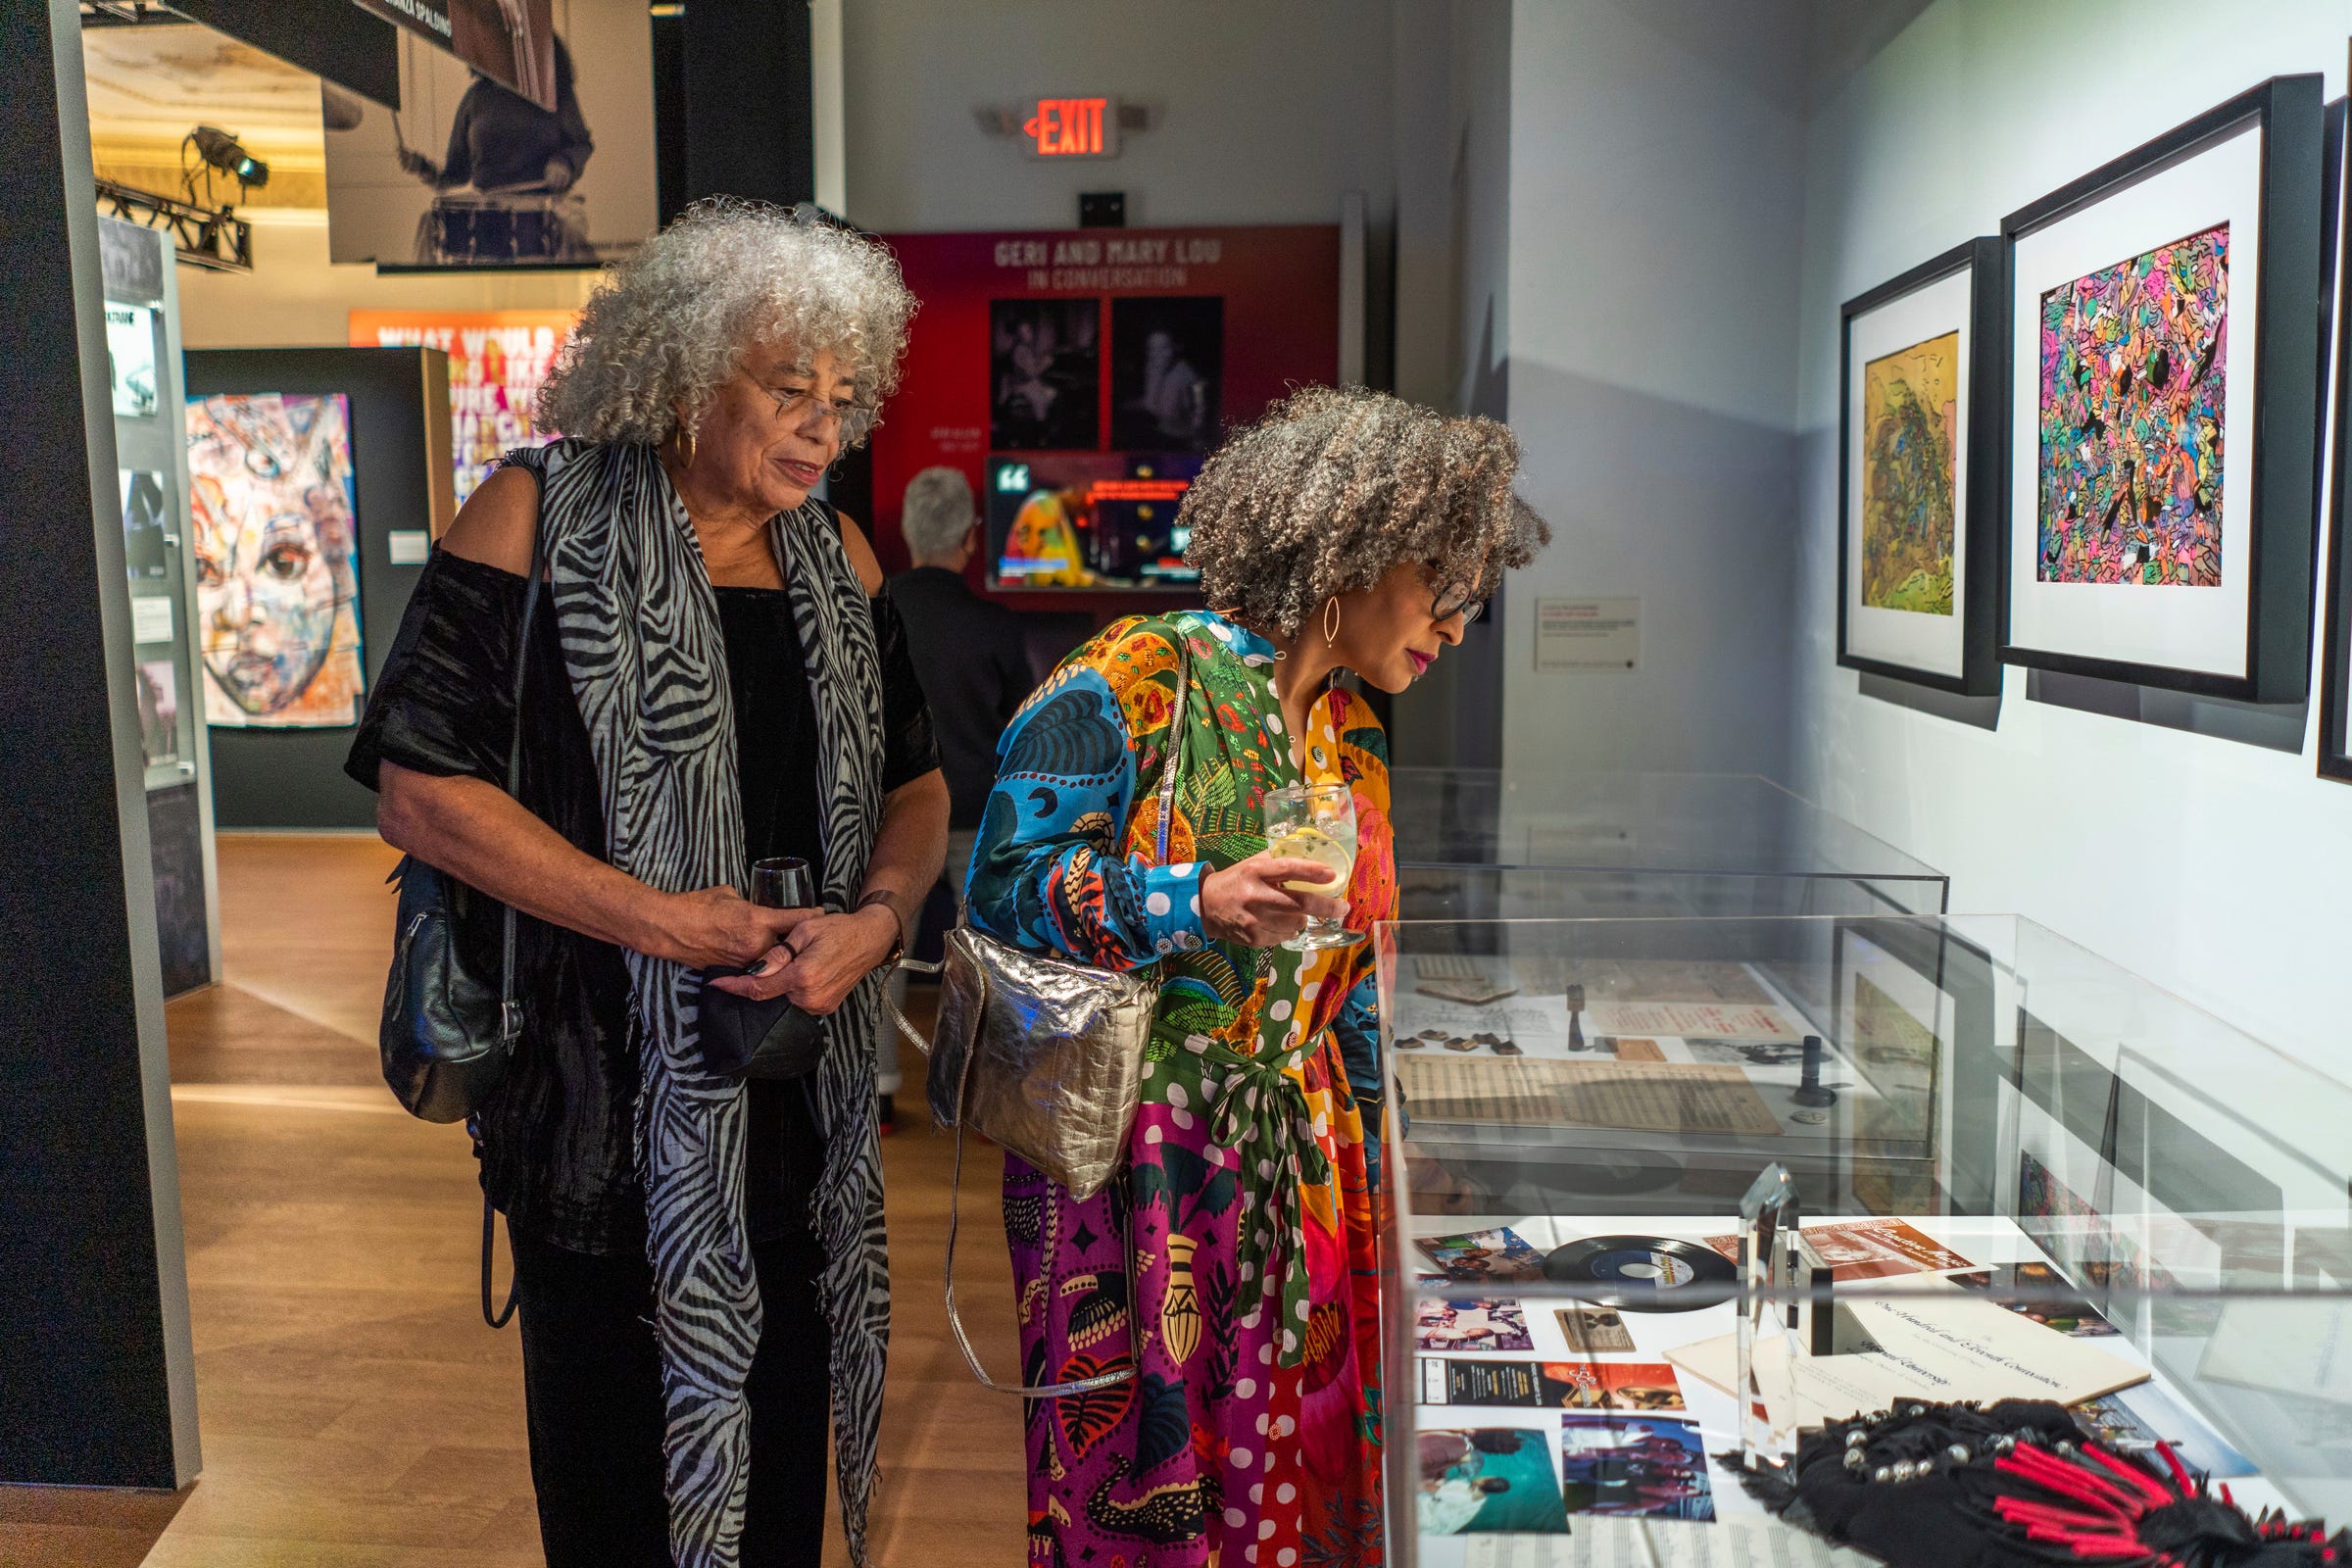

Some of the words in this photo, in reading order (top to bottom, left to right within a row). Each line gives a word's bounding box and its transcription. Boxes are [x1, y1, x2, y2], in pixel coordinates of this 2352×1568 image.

[1038, 99, 1106, 155] EXIT
[995, 241, 1047, 267] GERI
[1054, 241, 1101, 266] AND
[1106, 240, 1168, 265] MARY
[1176, 239, 1222, 265] LOU
[1027, 269, 1049, 290] IN
[1052, 268, 1188, 290] CONVERSATION
